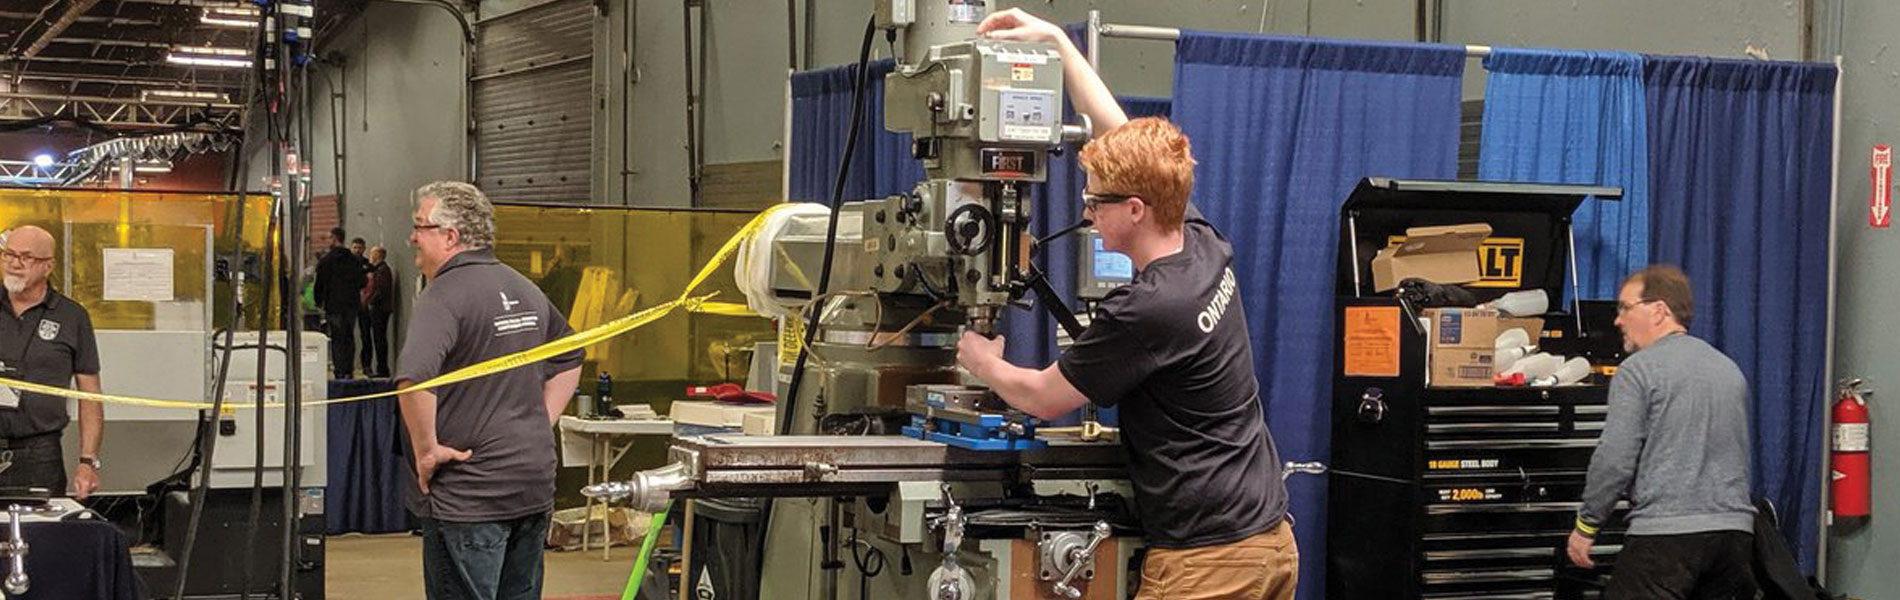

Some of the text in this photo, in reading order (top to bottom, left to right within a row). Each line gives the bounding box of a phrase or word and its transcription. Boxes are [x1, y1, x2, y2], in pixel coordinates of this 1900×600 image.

[992, 153, 1023, 170] FIRST
[1197, 266, 1236, 333] ONTARIO
[1460, 460, 1480, 469] STEEL
[1481, 459, 1499, 468] BODY
